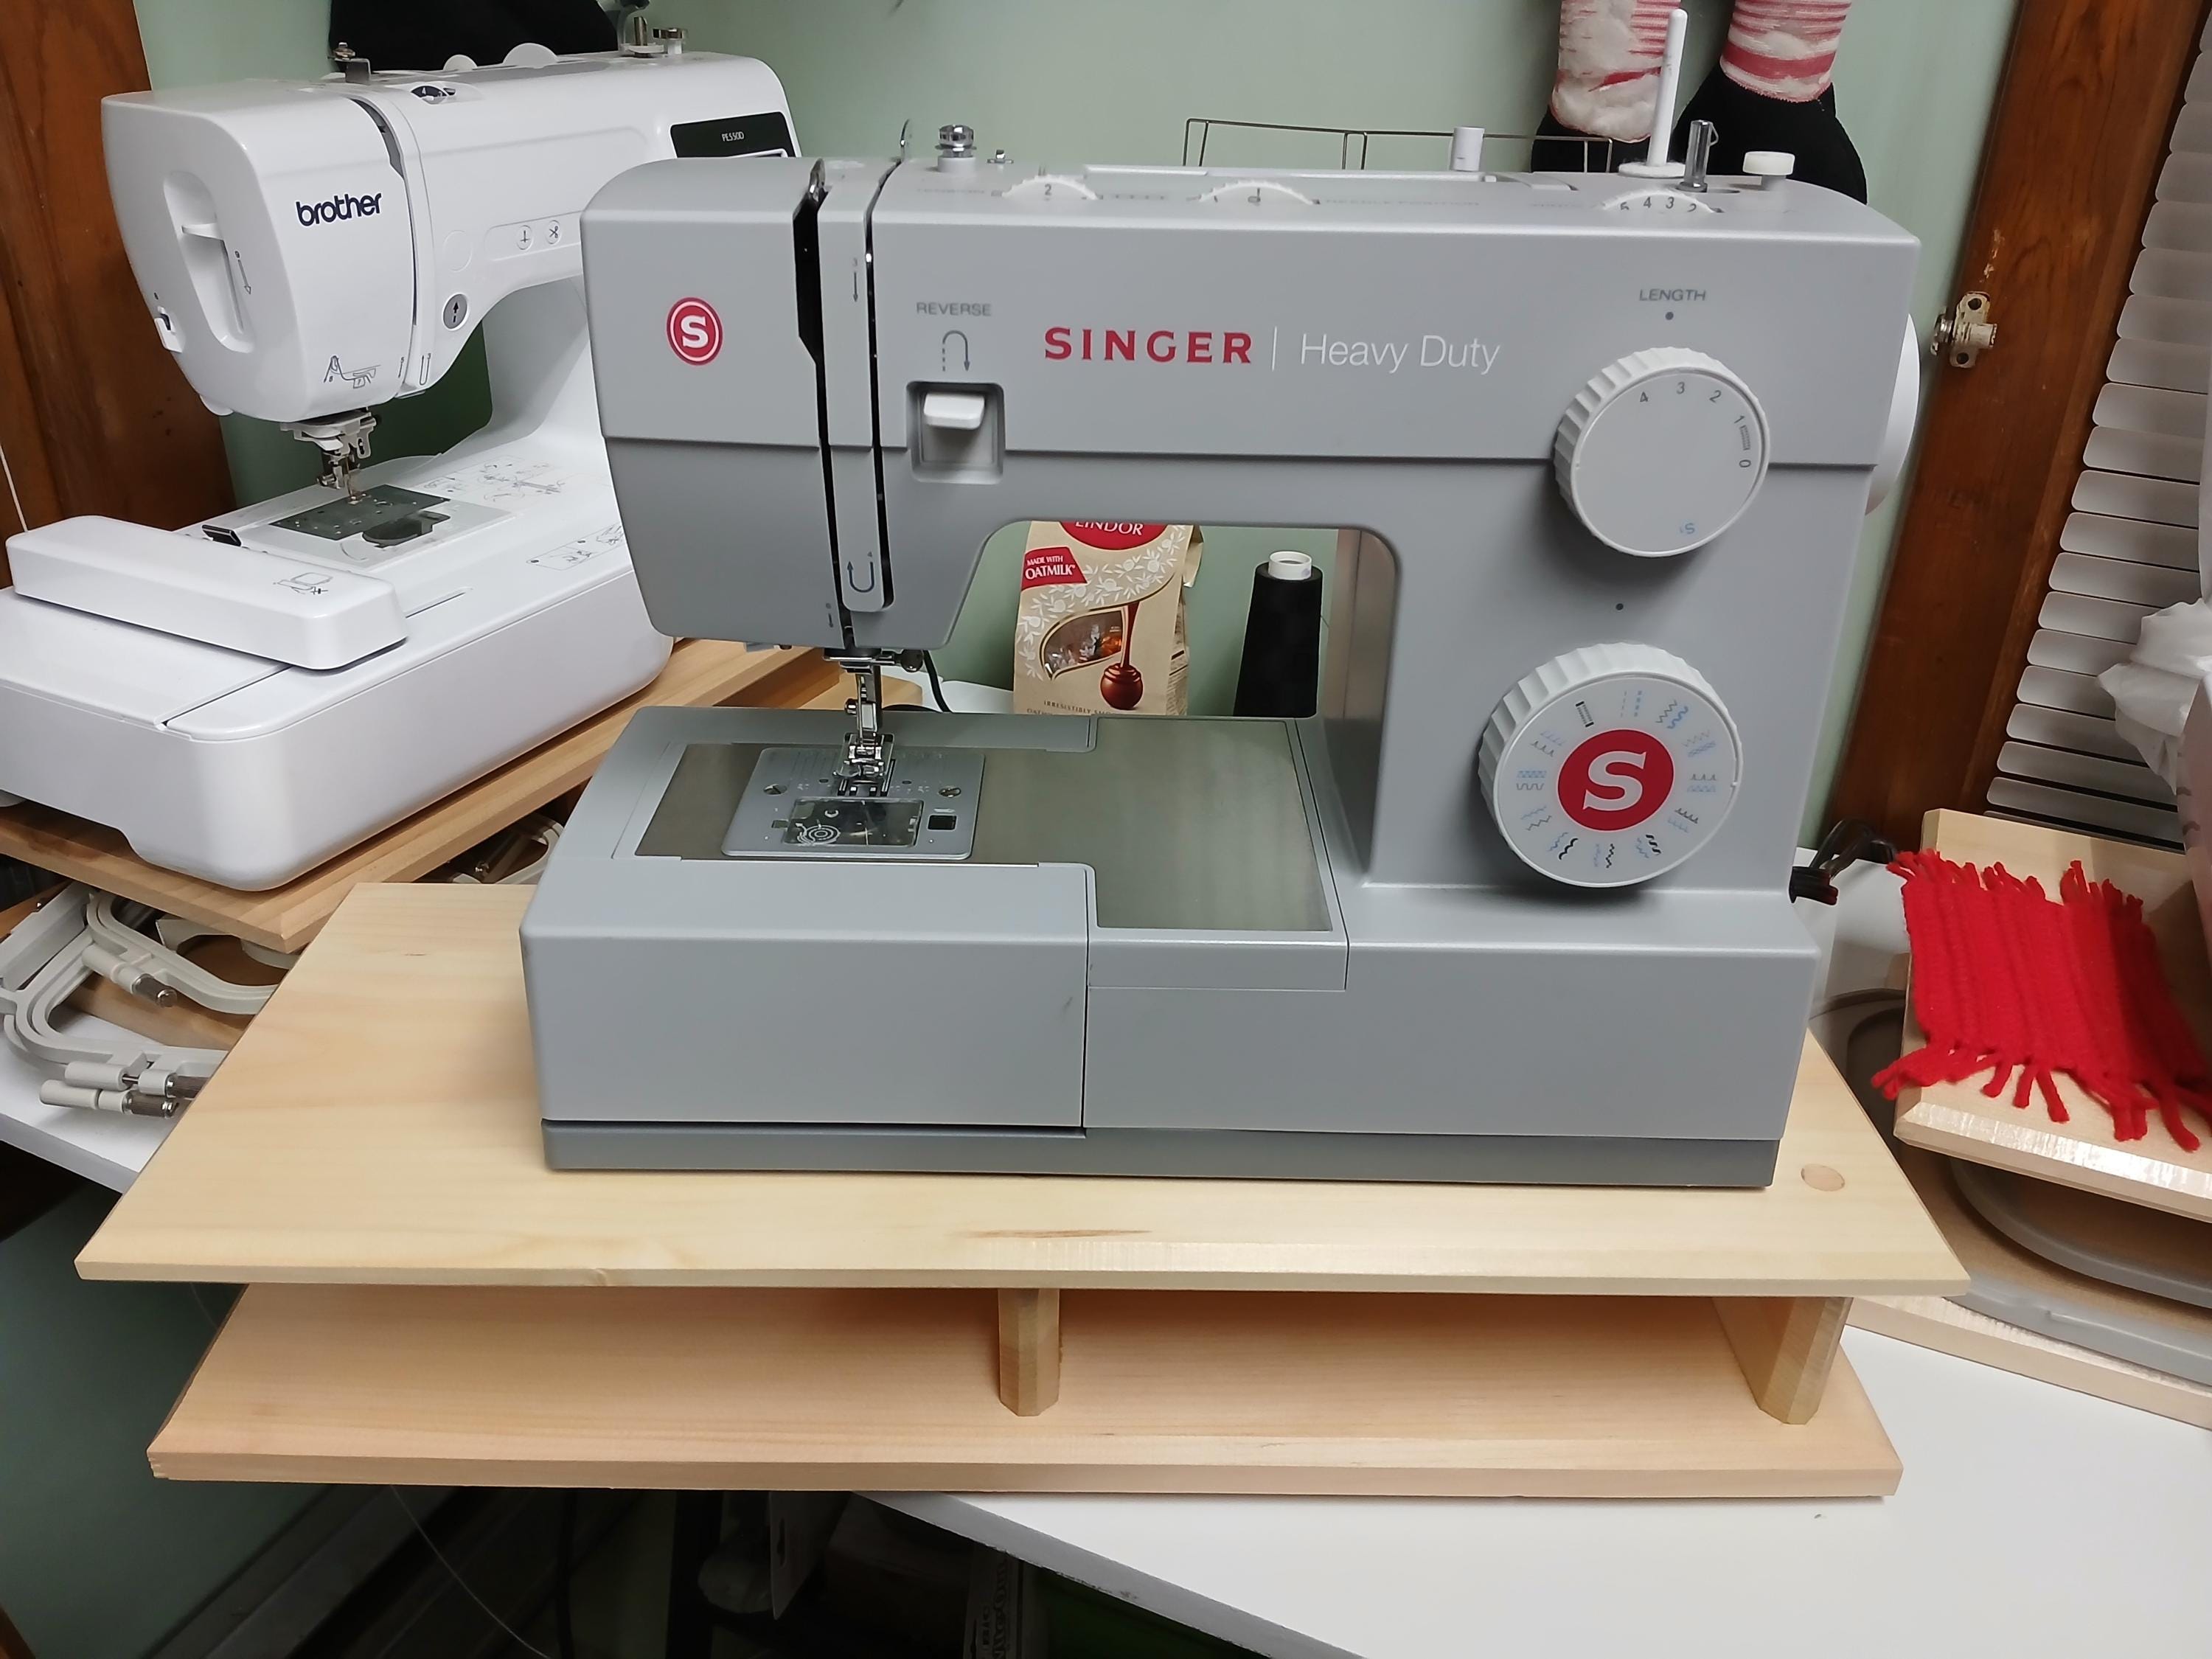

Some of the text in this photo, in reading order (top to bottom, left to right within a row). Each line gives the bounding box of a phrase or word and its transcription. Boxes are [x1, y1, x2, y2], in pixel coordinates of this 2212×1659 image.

[1044, 183, 1052, 196] 2
[296, 192, 382, 226] brother
[1643, 196, 1652, 209] 4
[1666, 196, 1674, 209] 3
[1639, 288, 1706, 302] LENGTH
[917, 302, 992, 317] REVERSE
[1044, 327, 1501, 375] SINGER Heavy Duty
[1639, 391, 1649, 403] 4
[1676, 381, 1686, 394] 3
[1709, 389, 1722, 403] 2
[1026, 557, 1046, 566] MADE
[1025, 564, 1075, 580] OATMILK
